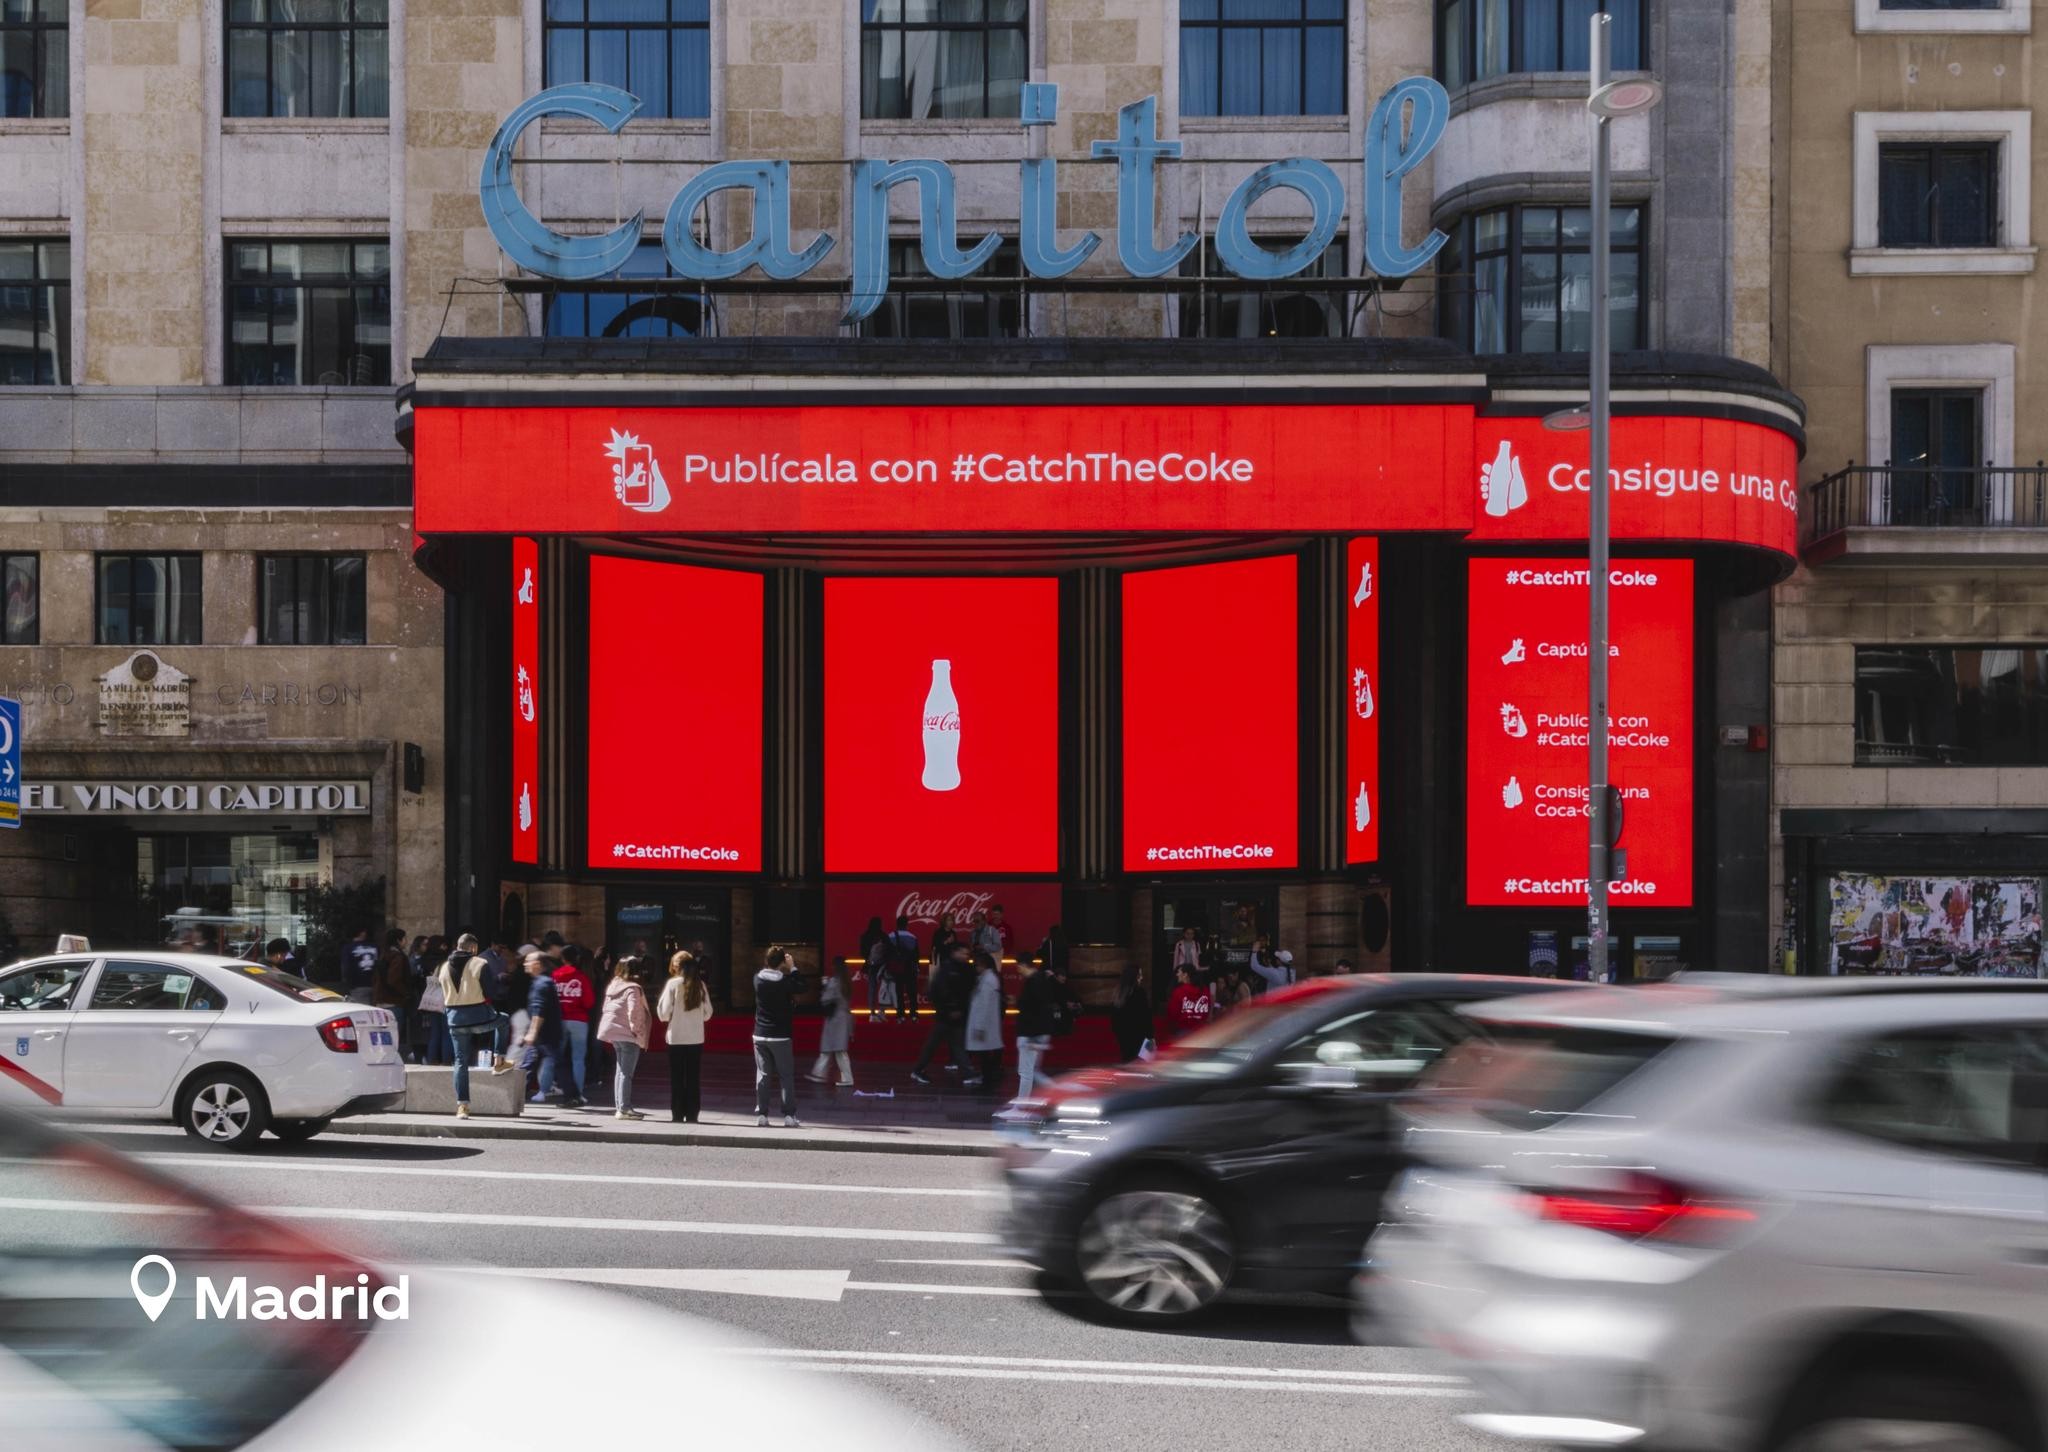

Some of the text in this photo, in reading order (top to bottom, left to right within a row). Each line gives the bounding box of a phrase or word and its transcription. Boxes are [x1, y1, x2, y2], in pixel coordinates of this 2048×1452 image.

[480, 76, 1450, 325] Capitol
[685, 452, 1254, 484] Publícala con #CatchTheCoke
[1730, 472, 1775, 502] una
[1505, 570, 1658, 586] #CatchTCoke
[1537, 642, 1620, 659] Captúa
[1537, 713, 1649, 728] Publíca con
[73, 784, 198, 811] VINCCI
[208, 784, 367, 811] CAPITOL
[1618, 787, 1650, 799] una
[612, 844, 739, 861] #CatchTheCoke
[1146, 844, 1274, 860] #CatchTheCoke
[1504, 878, 1656, 894] #CatchTCoke
